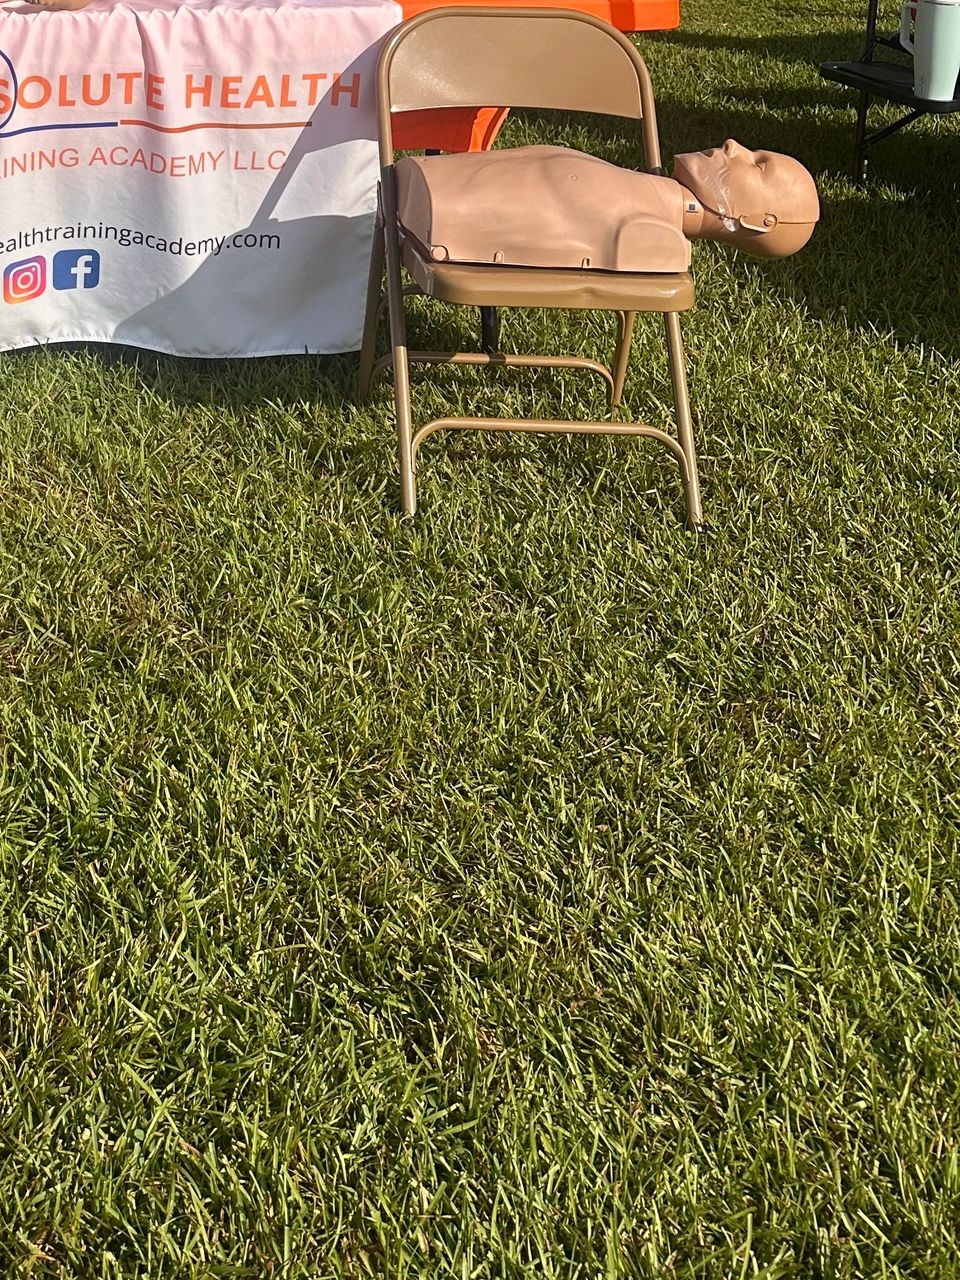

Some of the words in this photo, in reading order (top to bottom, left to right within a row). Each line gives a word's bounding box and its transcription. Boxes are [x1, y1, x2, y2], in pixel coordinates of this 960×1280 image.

[185, 72, 361, 109] HEALTH
[88, 146, 225, 177] ACADEMY
[233, 150, 287, 171] LLC
